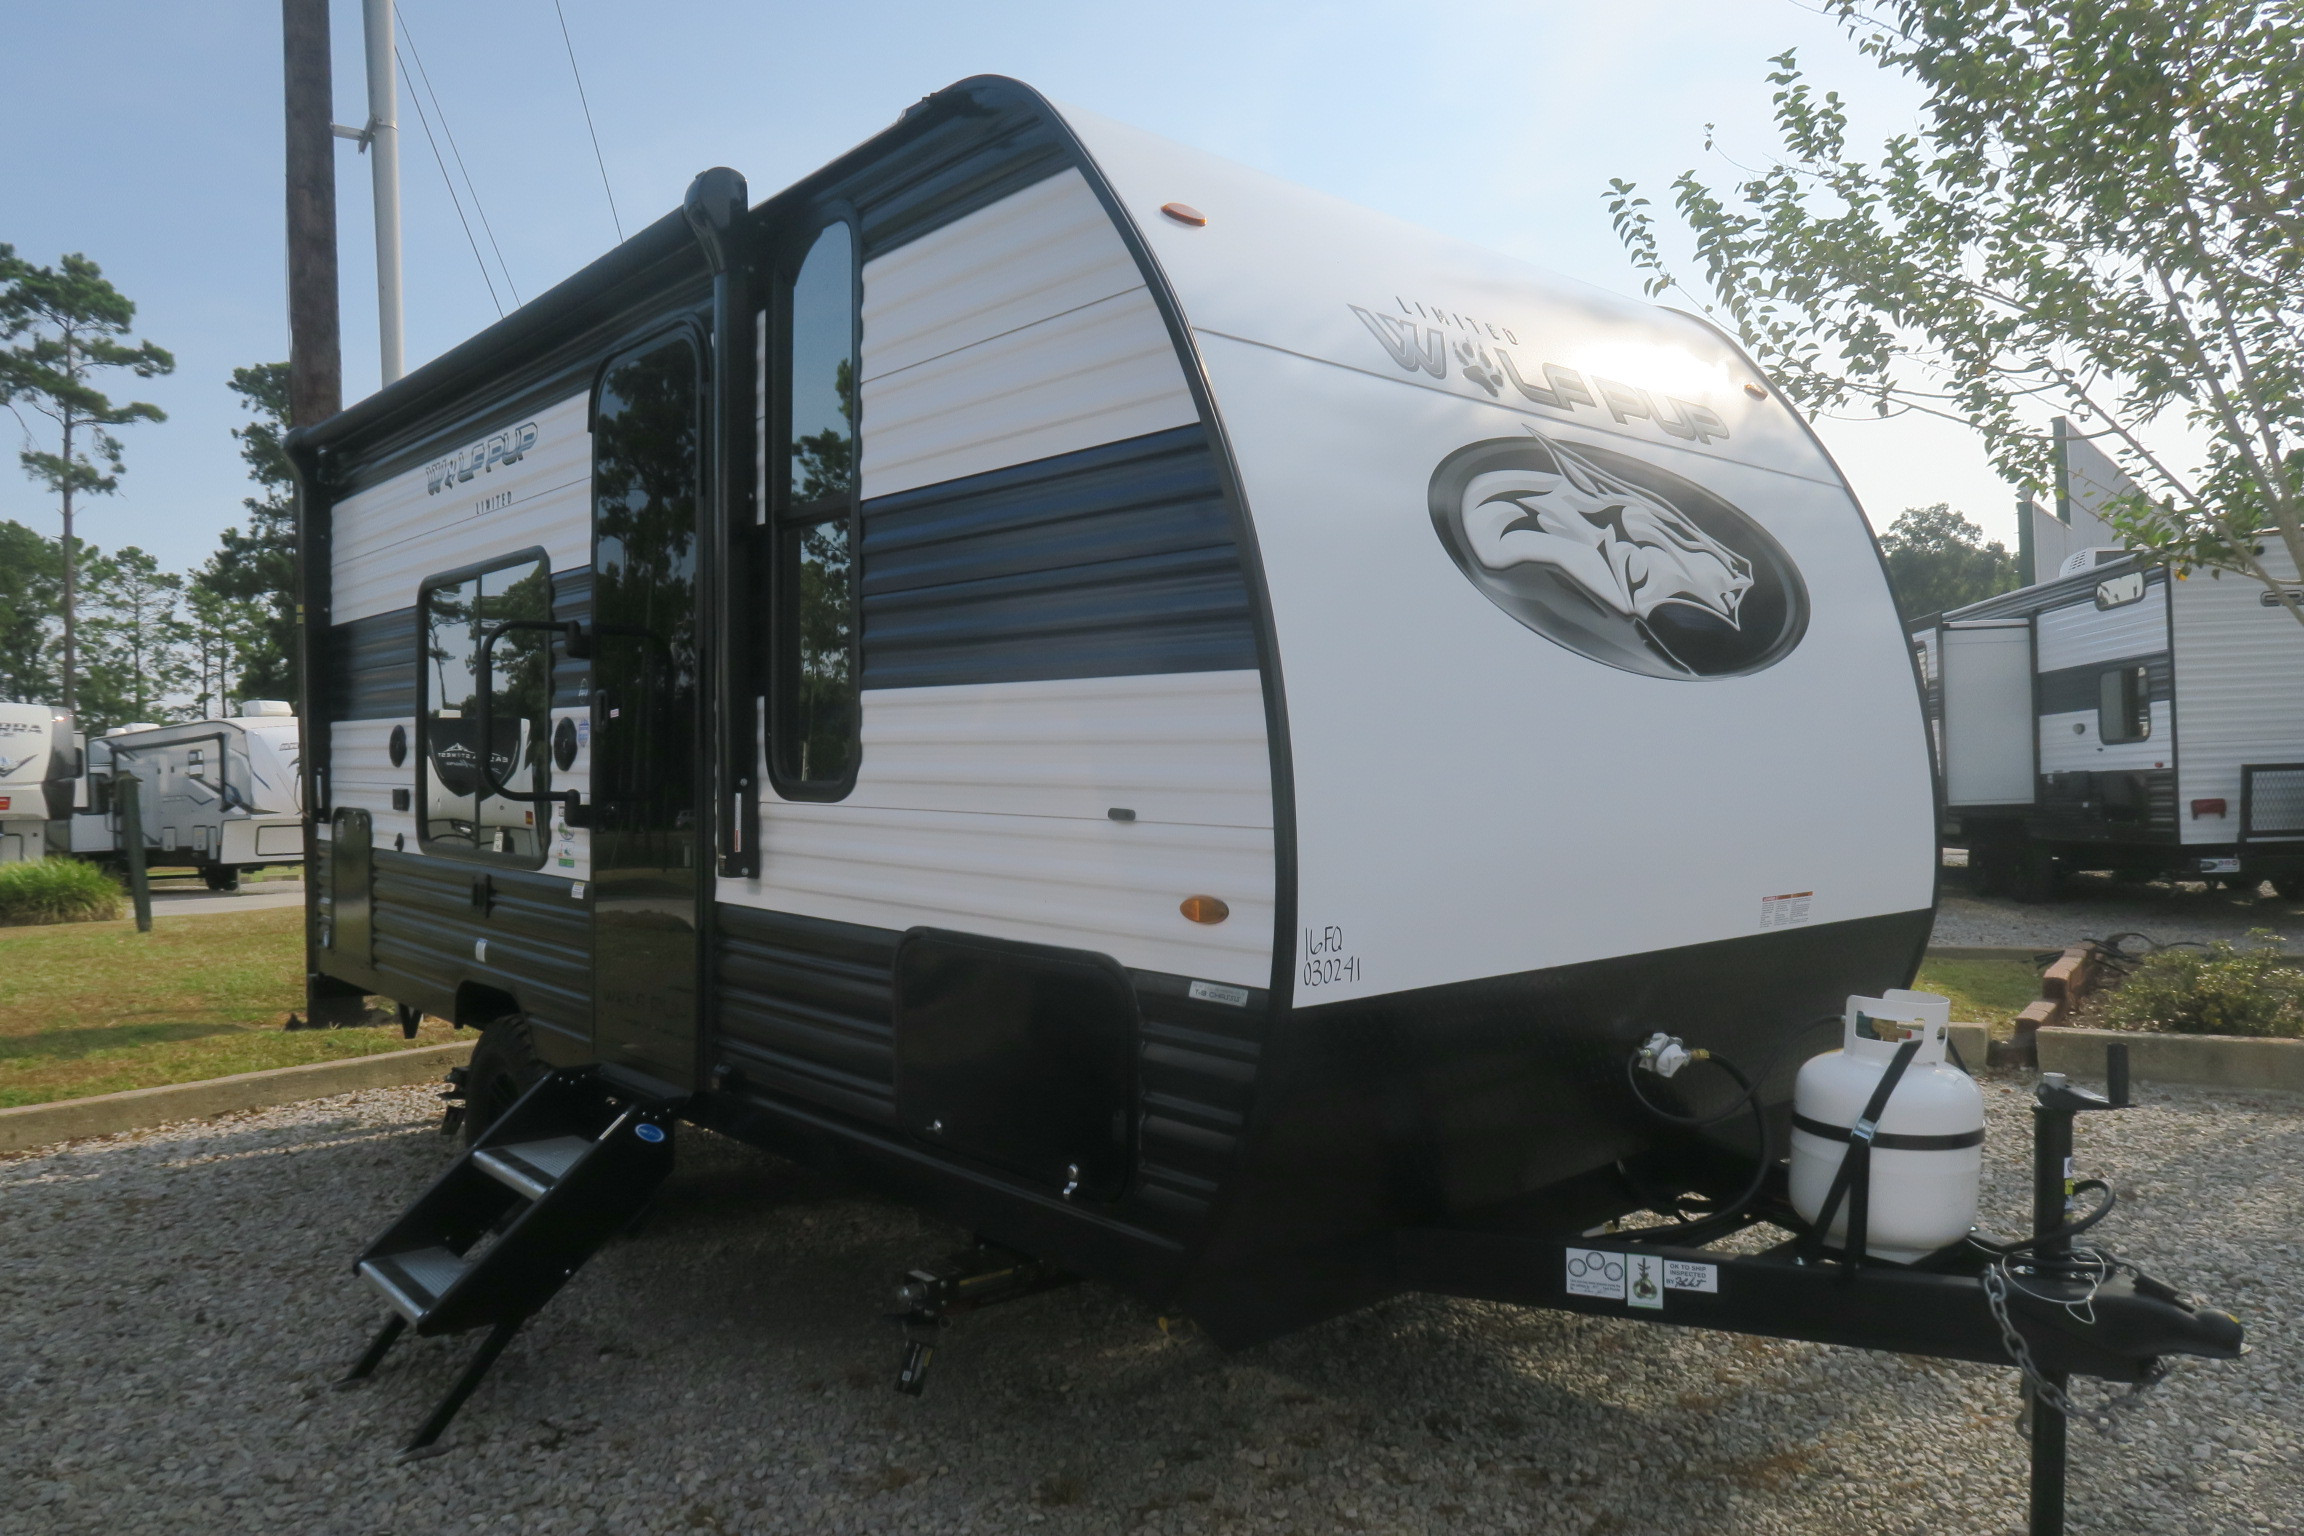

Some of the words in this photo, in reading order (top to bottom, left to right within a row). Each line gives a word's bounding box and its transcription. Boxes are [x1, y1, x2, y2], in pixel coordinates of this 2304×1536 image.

[1395, 295, 1519, 346] LIMITED
[1590, 374, 1731, 446] PUP
[486, 421, 539, 473] PUP
[475, 491, 513, 515] LIMITED
[1303, 955, 1361, 987] 030241
[1669, 1270, 1707, 1278] INSPECTED
